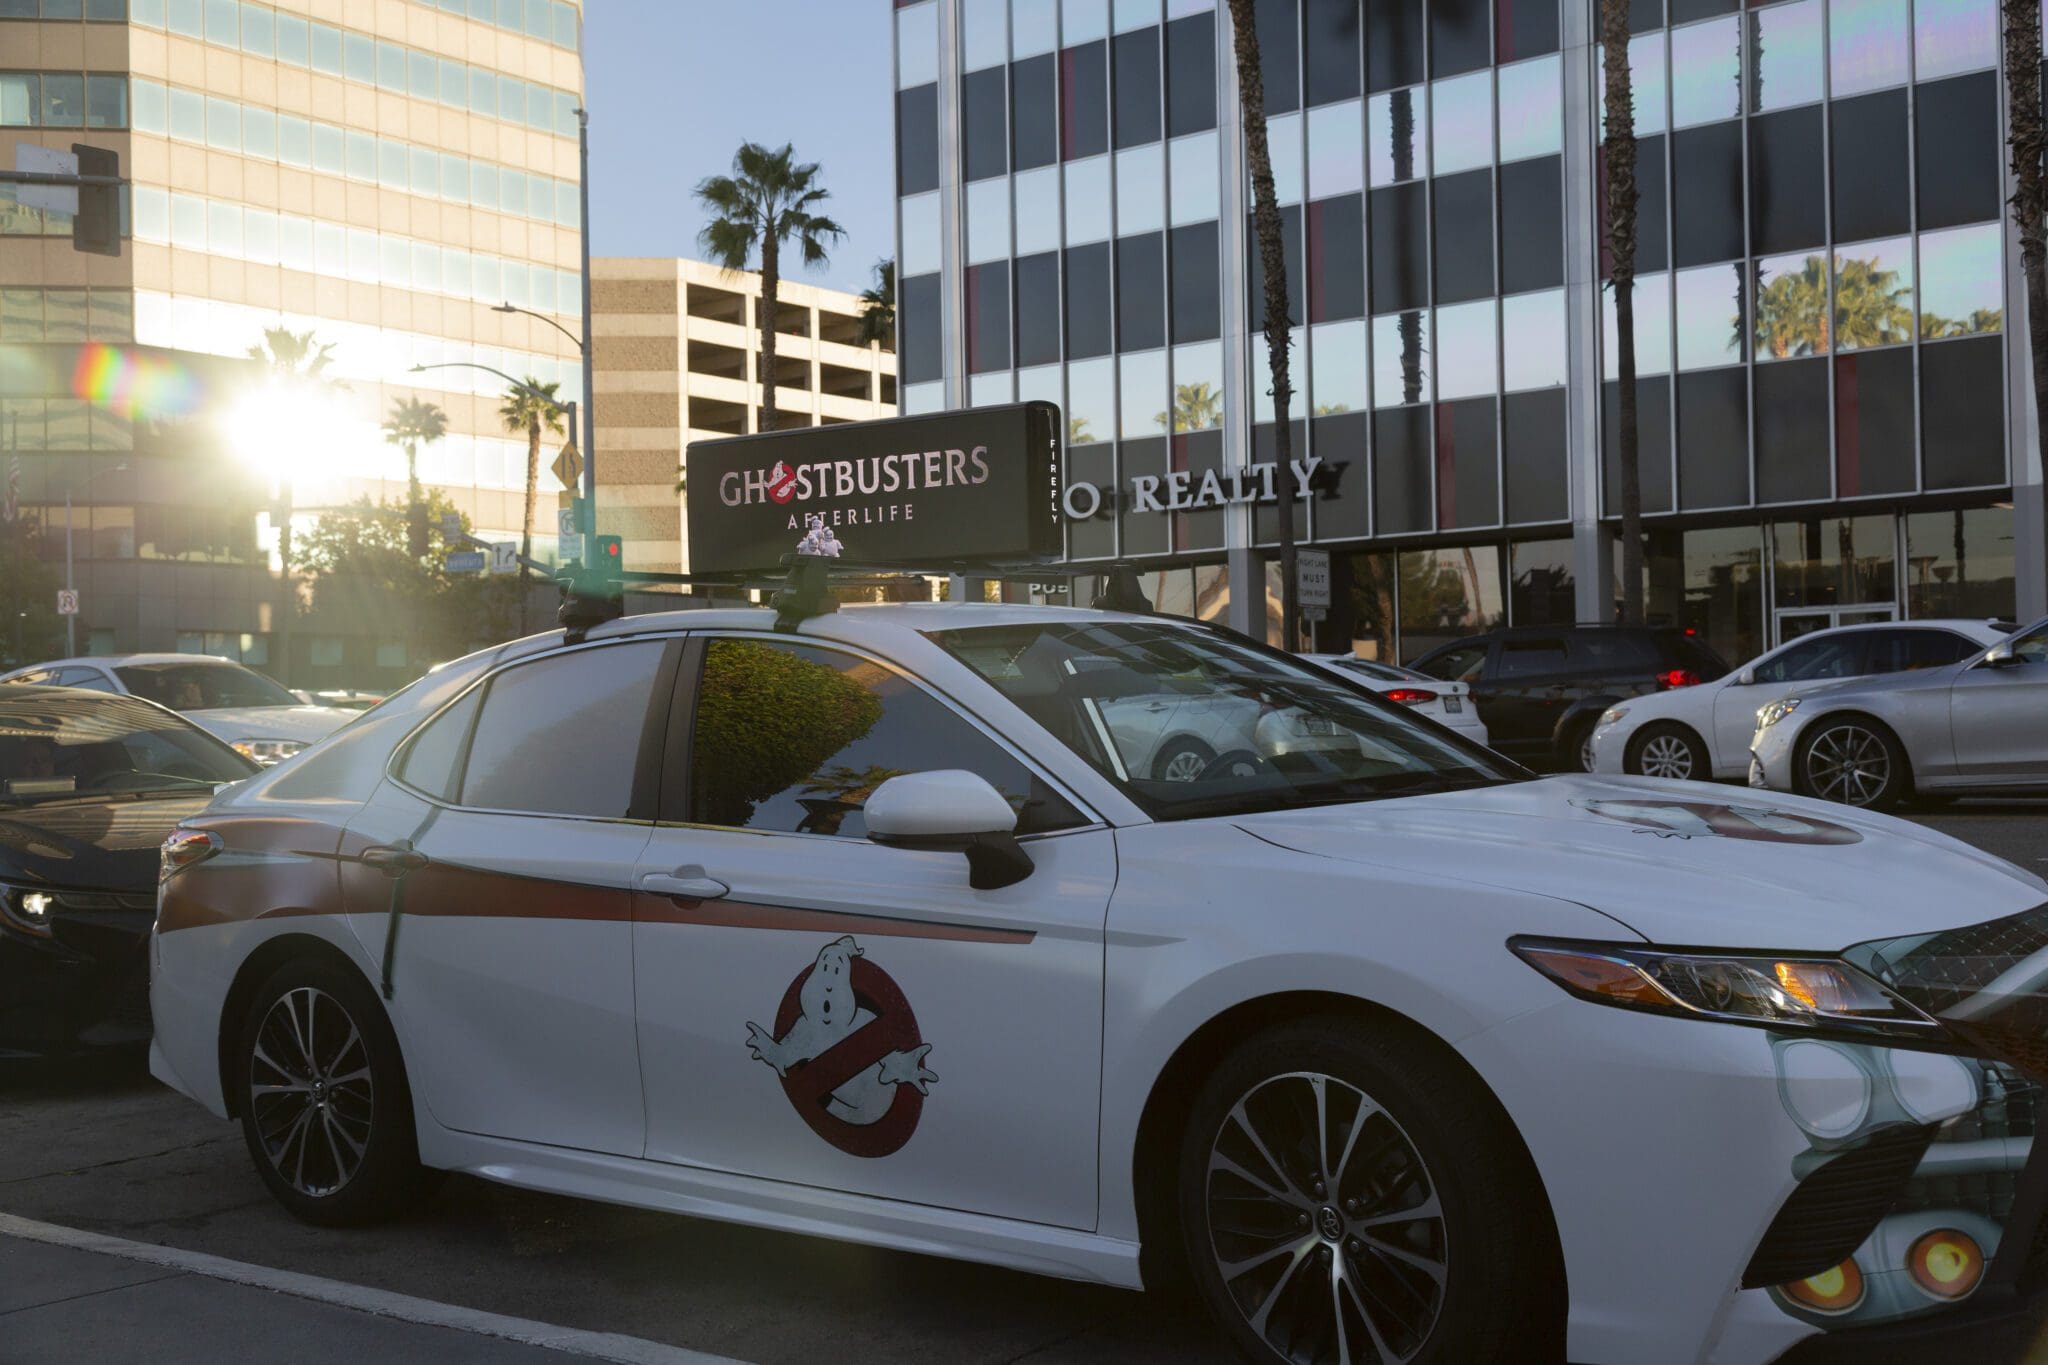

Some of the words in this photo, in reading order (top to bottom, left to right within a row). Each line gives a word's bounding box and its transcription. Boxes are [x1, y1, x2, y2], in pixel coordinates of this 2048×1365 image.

[1131, 456, 1324, 513] REALTY
[787, 504, 913, 529] AFTERLIFE
[1302, 574, 1325, 584] MUST
